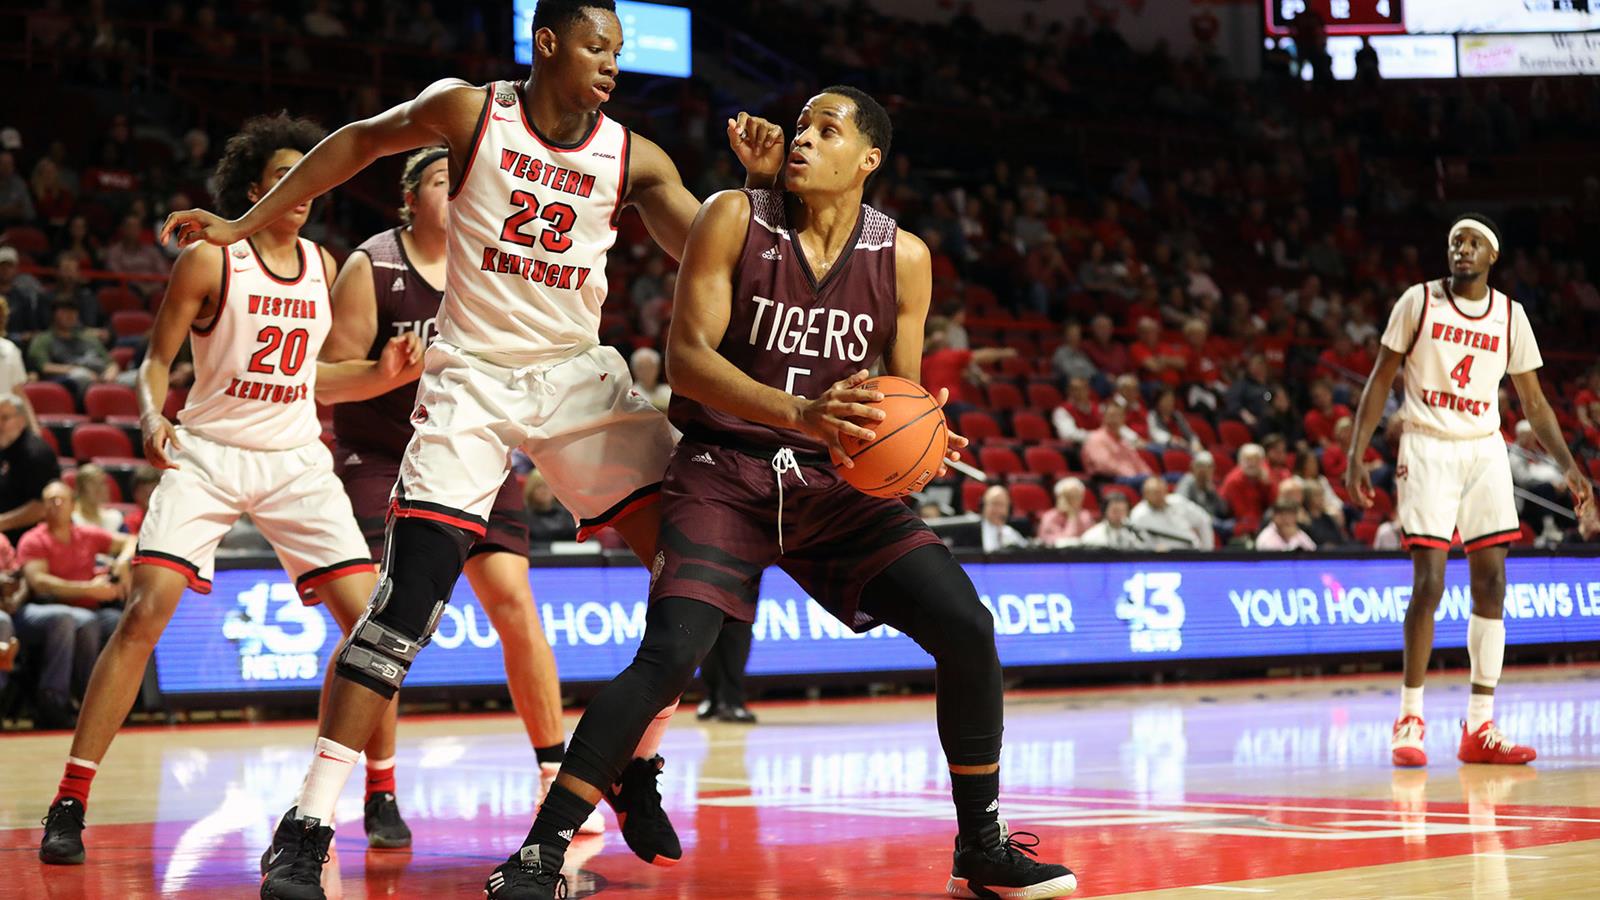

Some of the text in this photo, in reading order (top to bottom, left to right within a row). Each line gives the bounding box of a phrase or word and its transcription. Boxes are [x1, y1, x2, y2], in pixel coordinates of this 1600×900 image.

[500, 148, 596, 199] WESTERN
[500, 189, 577, 254] 23
[481, 246, 591, 290] KENTUCKY
[248, 294, 316, 319] WESTERN
[749, 295, 873, 363] TIGERS
[247, 325, 309, 377] 20
[1431, 322, 1500, 353] WESTERN
[1450, 354, 1475, 389] 4
[237, 582, 327, 655] 13
[1121, 572, 1186, 630] 13
[1228, 588, 1320, 627] YOUR
[241, 653, 319, 680] NEWS
